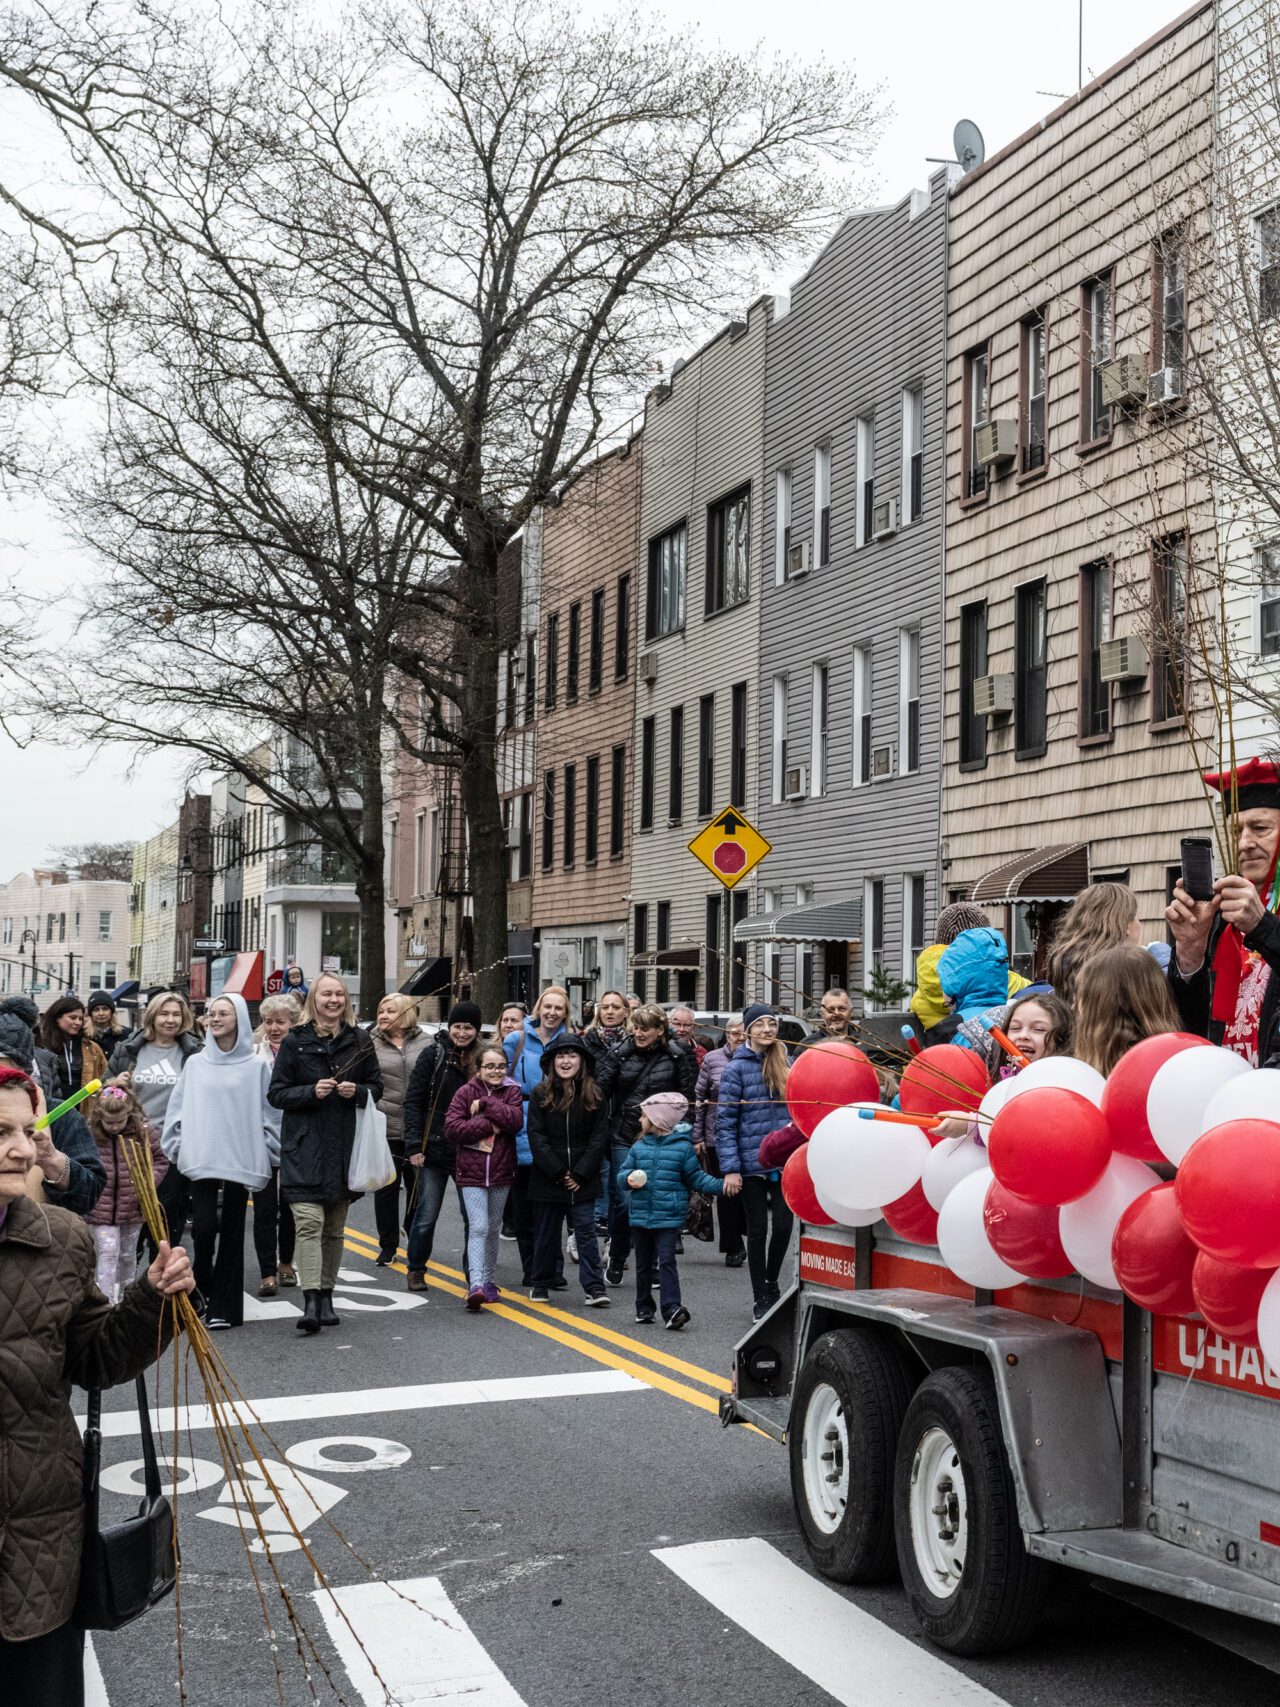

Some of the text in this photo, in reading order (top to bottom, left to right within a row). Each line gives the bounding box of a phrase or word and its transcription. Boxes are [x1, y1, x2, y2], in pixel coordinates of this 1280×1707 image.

[801, 1251, 856, 1278] MOVING MADE EAS
